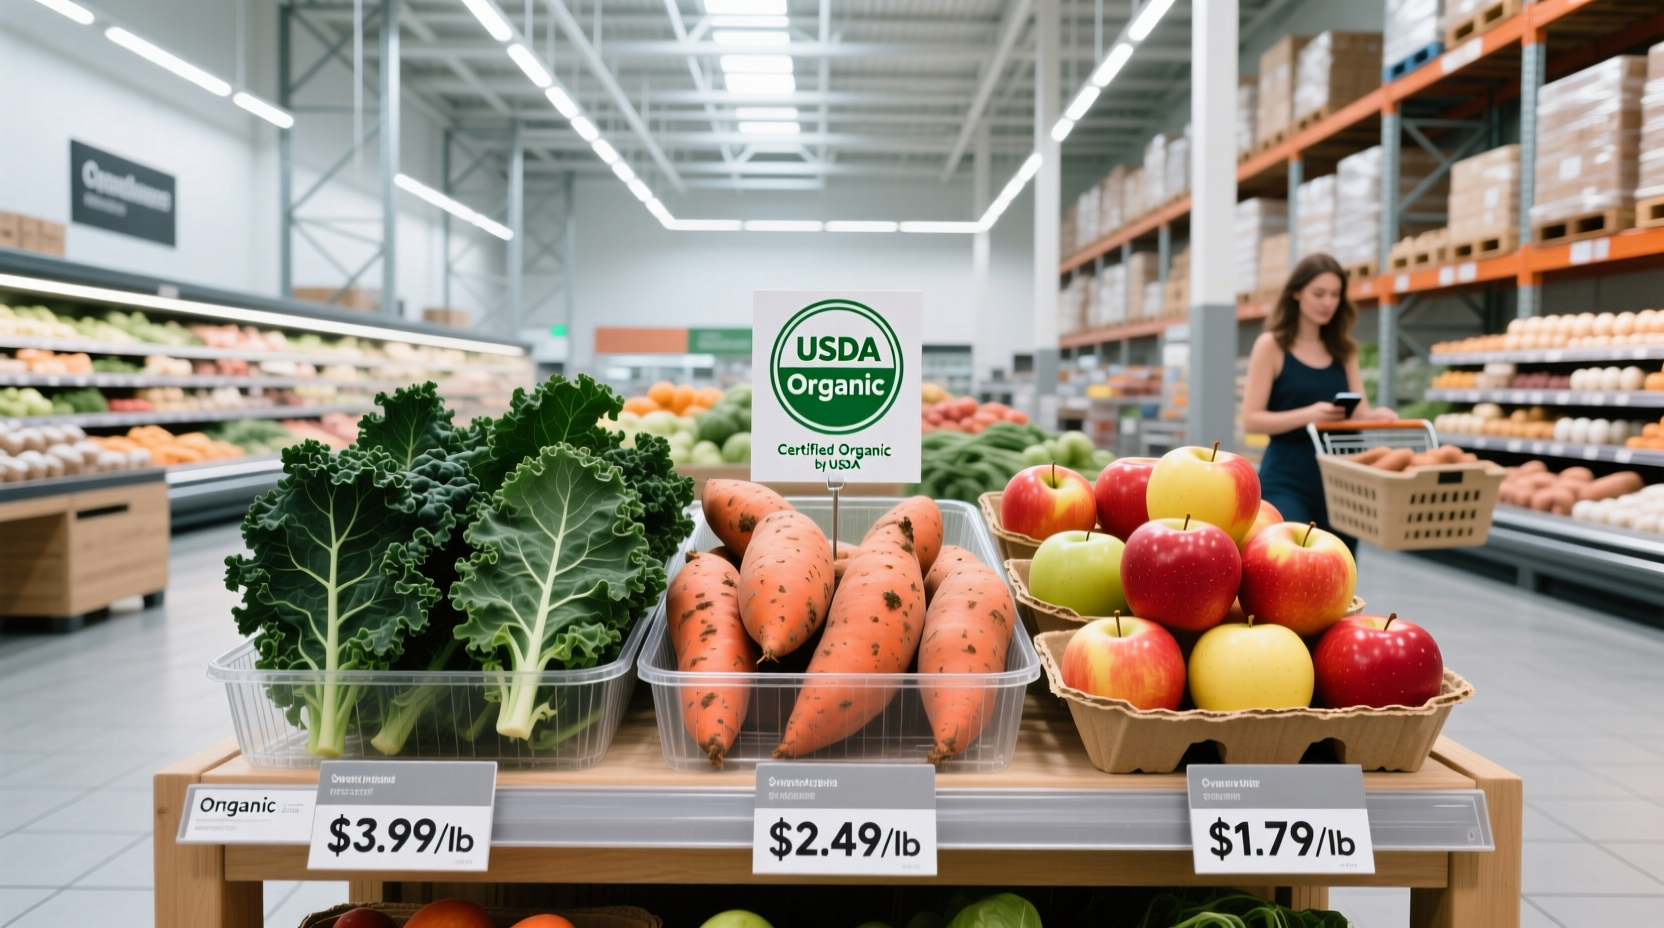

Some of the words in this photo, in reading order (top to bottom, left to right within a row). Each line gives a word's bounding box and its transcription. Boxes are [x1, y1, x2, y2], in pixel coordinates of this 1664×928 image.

[797, 336, 881, 362] USDA
[787, 373, 885, 402] Organic
[778, 443, 834, 456] Certified
[838, 443, 892, 460] Organic
[815, 459, 827, 472] by
[200, 796, 276, 817] Organic
[328, 814, 474, 857] $3.99/lb
[769, 817, 921, 861] $2.49/lb
[1209, 817, 1356, 861] $1.79/lb
